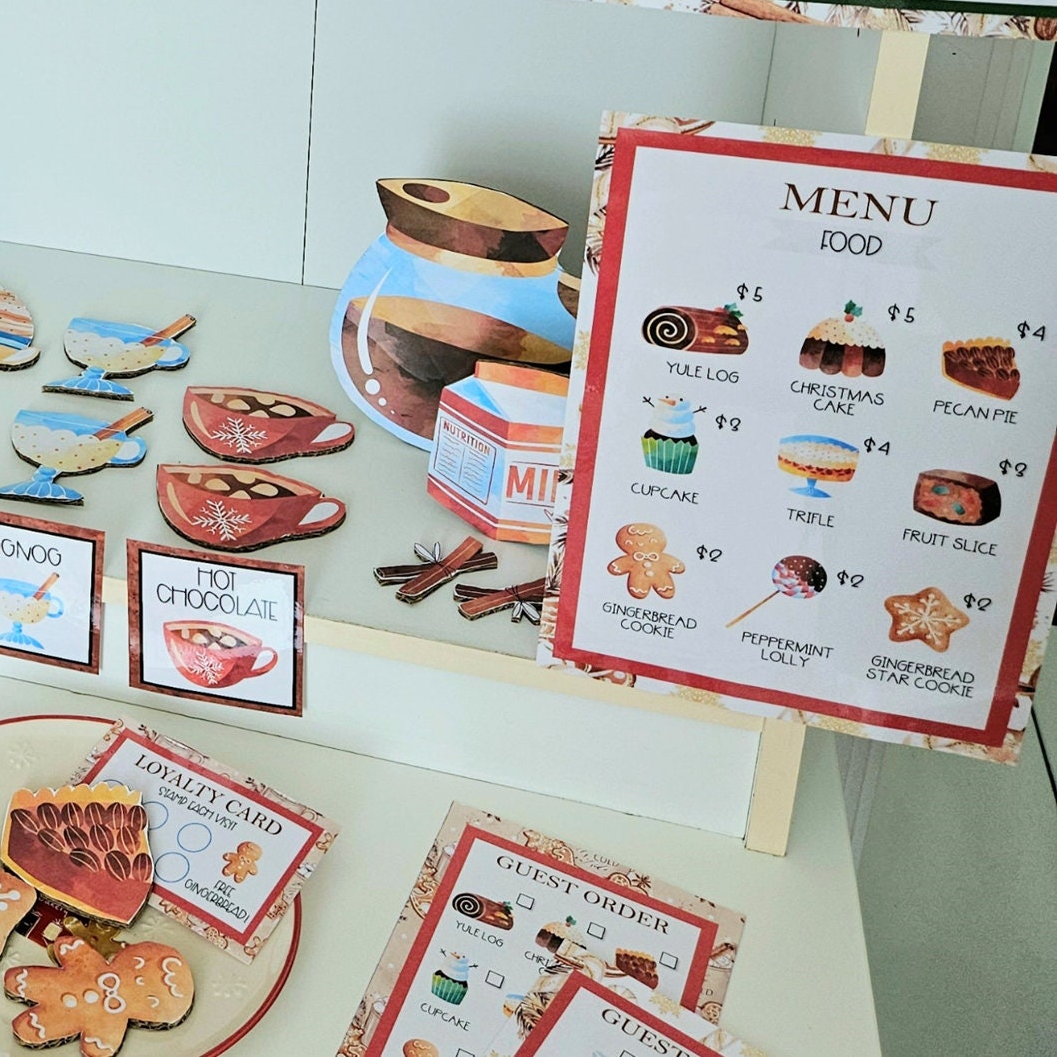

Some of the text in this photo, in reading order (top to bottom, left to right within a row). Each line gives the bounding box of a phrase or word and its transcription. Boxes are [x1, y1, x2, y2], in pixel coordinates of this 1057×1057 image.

[779, 183, 939, 226] MENU
[820, 229, 883, 256] FOOD
[736, 283, 764, 303] $5
[887, 303, 916, 324] $5
[1017, 321, 1047, 342] $4
[666, 361, 740, 384] YULE LOG
[790, 380, 885, 406] CHRISTMAS
[813, 398, 855, 416] CAKE
[933, 400, 1018, 424] PECAN PIE
[443, 421, 490, 455] NUTRITION
[863, 437, 890, 456] $4
[630, 482, 700, 506] CUPCAKE
[787, 508, 835, 528] TRIFLE
[696, 544, 723, 564] $2
[902, 528, 998, 558] FRUIT SLICE
[196, 566, 236, 594] HOT
[837, 569, 865, 590] $2
[156, 583, 279, 623] CHOCOLATE
[963, 592, 993, 613] $2
[602, 601, 697, 631] GINGERBREAD
[620, 619, 675, 640] COOKIE
[741, 631, 834, 660] PEPPERMINT
[761, 647, 810, 669] LOLLY
[871, 655, 975, 684] GINGERBREAD
[866, 668, 974, 699] STAR COOKIE
[134, 753, 283, 836] LOYALTY CARD
[158, 785, 239, 831] STAMP EACH VISIT
[213, 880, 237, 899] FREE
[496, 854, 580, 896] GUEST
[583, 890, 670, 935] ORDER
[455, 920, 504, 947] YULE LOG
[420, 1002, 471, 1032] CUPCAKE
